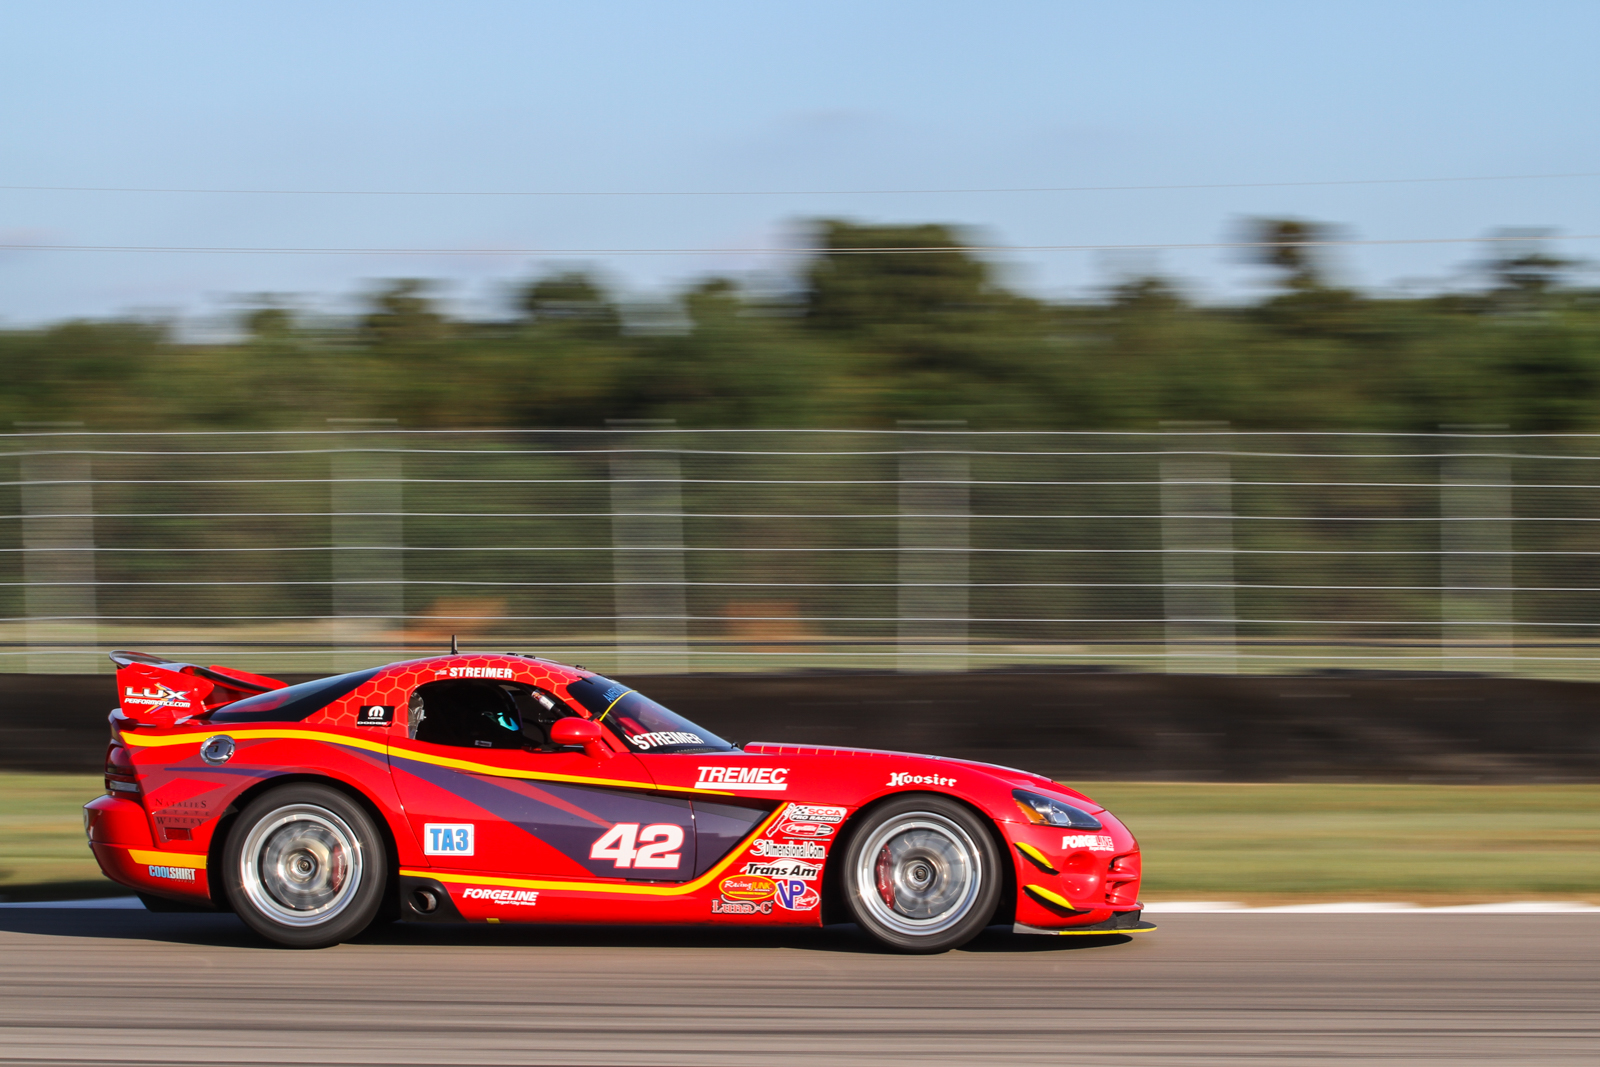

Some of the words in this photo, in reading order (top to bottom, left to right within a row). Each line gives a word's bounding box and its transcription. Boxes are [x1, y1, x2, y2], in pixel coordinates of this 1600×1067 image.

[449, 667, 512, 678] STREIMER
[125, 686, 189, 701] LUX
[632, 731, 704, 750] STREIMER
[698, 766, 788, 783] TREMEC
[886, 772, 957, 787] Hoosier
[809, 808, 841, 816] SCCA
[430, 828, 469, 851] TA3
[589, 822, 685, 869] 42
[1062, 835, 1114, 849] FORGELINE
[748, 864, 787, 875] Trans
[790, 865, 817, 876] Am
[462, 888, 539, 902] FORGELINE
[777, 880, 805, 909] VP
[712, 896, 773, 914] Luna-C
